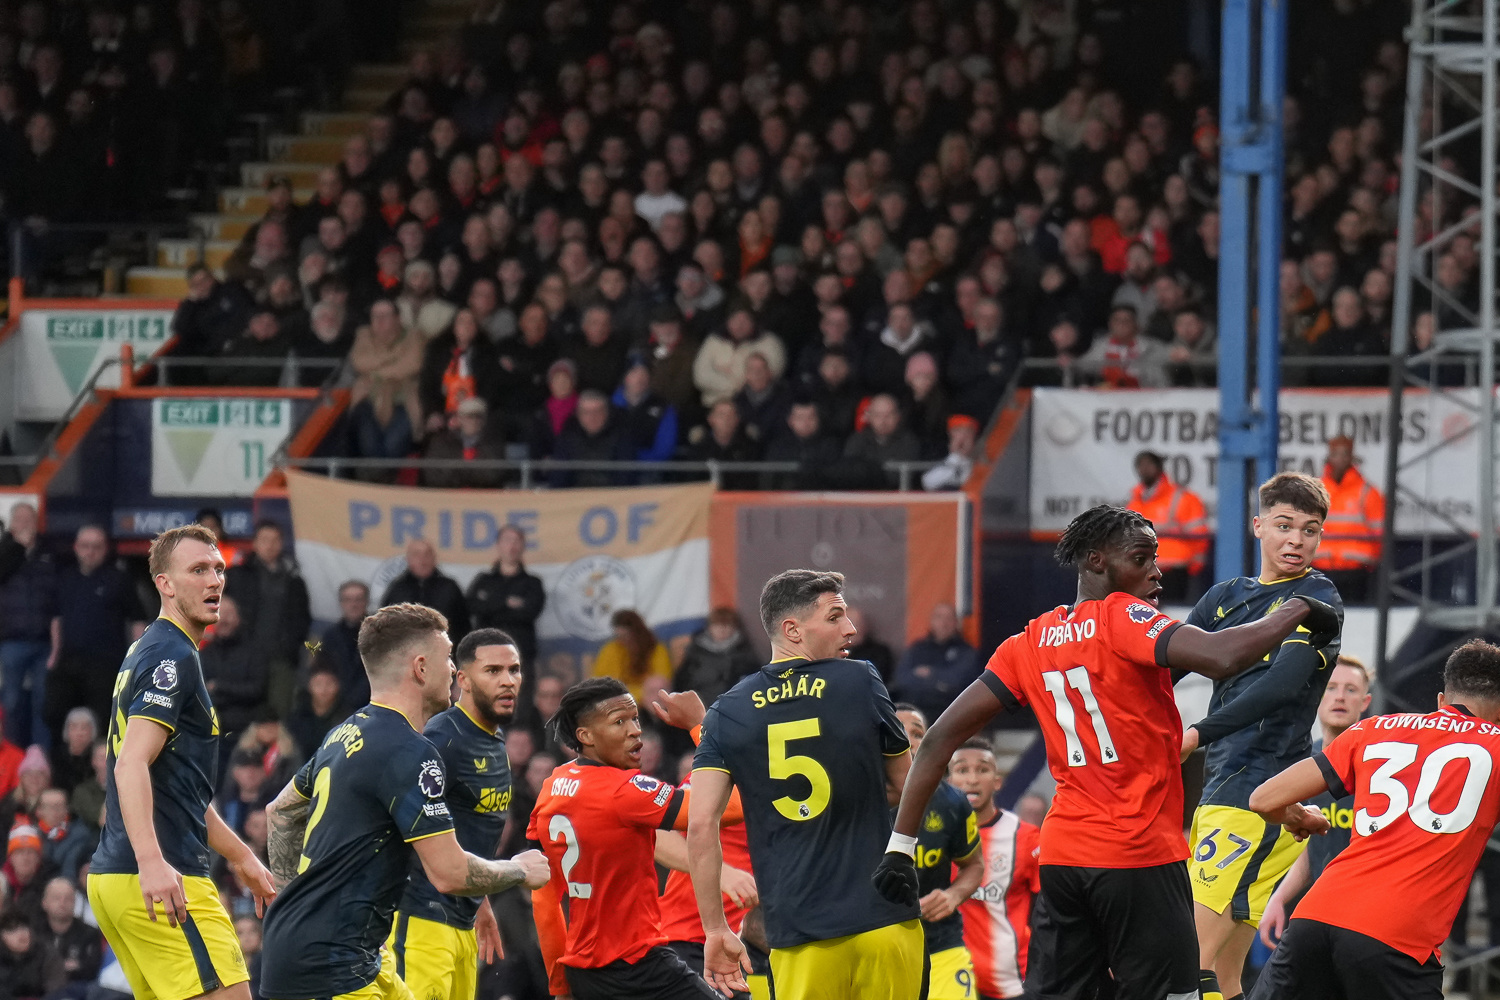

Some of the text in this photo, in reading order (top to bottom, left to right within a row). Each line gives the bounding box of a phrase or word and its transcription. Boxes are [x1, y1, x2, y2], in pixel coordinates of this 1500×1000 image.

[166, 402, 210, 422] EXIT
[1094, 410, 1426, 443] FOOTBA BELONS
[240, 440, 264, 480] 11
[348, 501, 660, 550] PRIDE OF
[752, 674, 826, 708] SCHÄR
[1041, 665, 1119, 767] 11
[1373, 715, 1475, 734] TOWNSEND
[767, 717, 831, 821] 5
[551, 777, 580, 797] OSHO
[1355, 741, 1493, 837] 30
[1322, 802, 1353, 829] ela
[549, 814, 592, 899] 2
[915, 845, 942, 869] la
[1194, 828, 1251, 870] 67
[955, 969, 971, 998] 9
